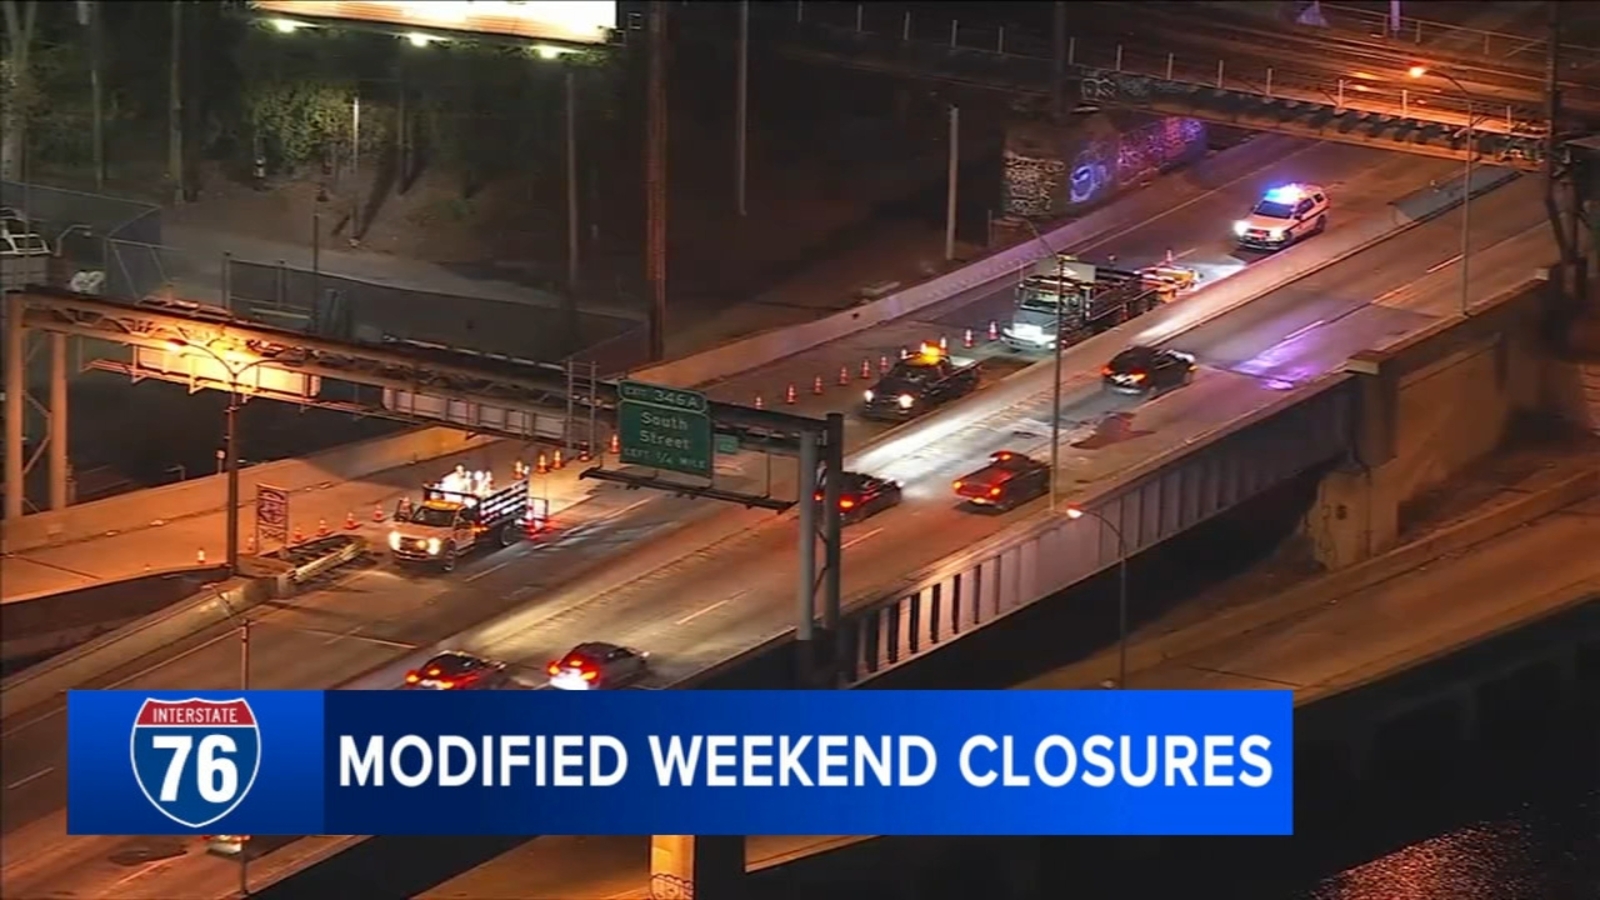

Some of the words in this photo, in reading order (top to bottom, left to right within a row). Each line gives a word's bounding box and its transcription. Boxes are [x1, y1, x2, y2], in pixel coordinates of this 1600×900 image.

[654, 389, 699, 407] 346A
[641, 411, 688, 430] South
[640, 430, 691, 450] Street
